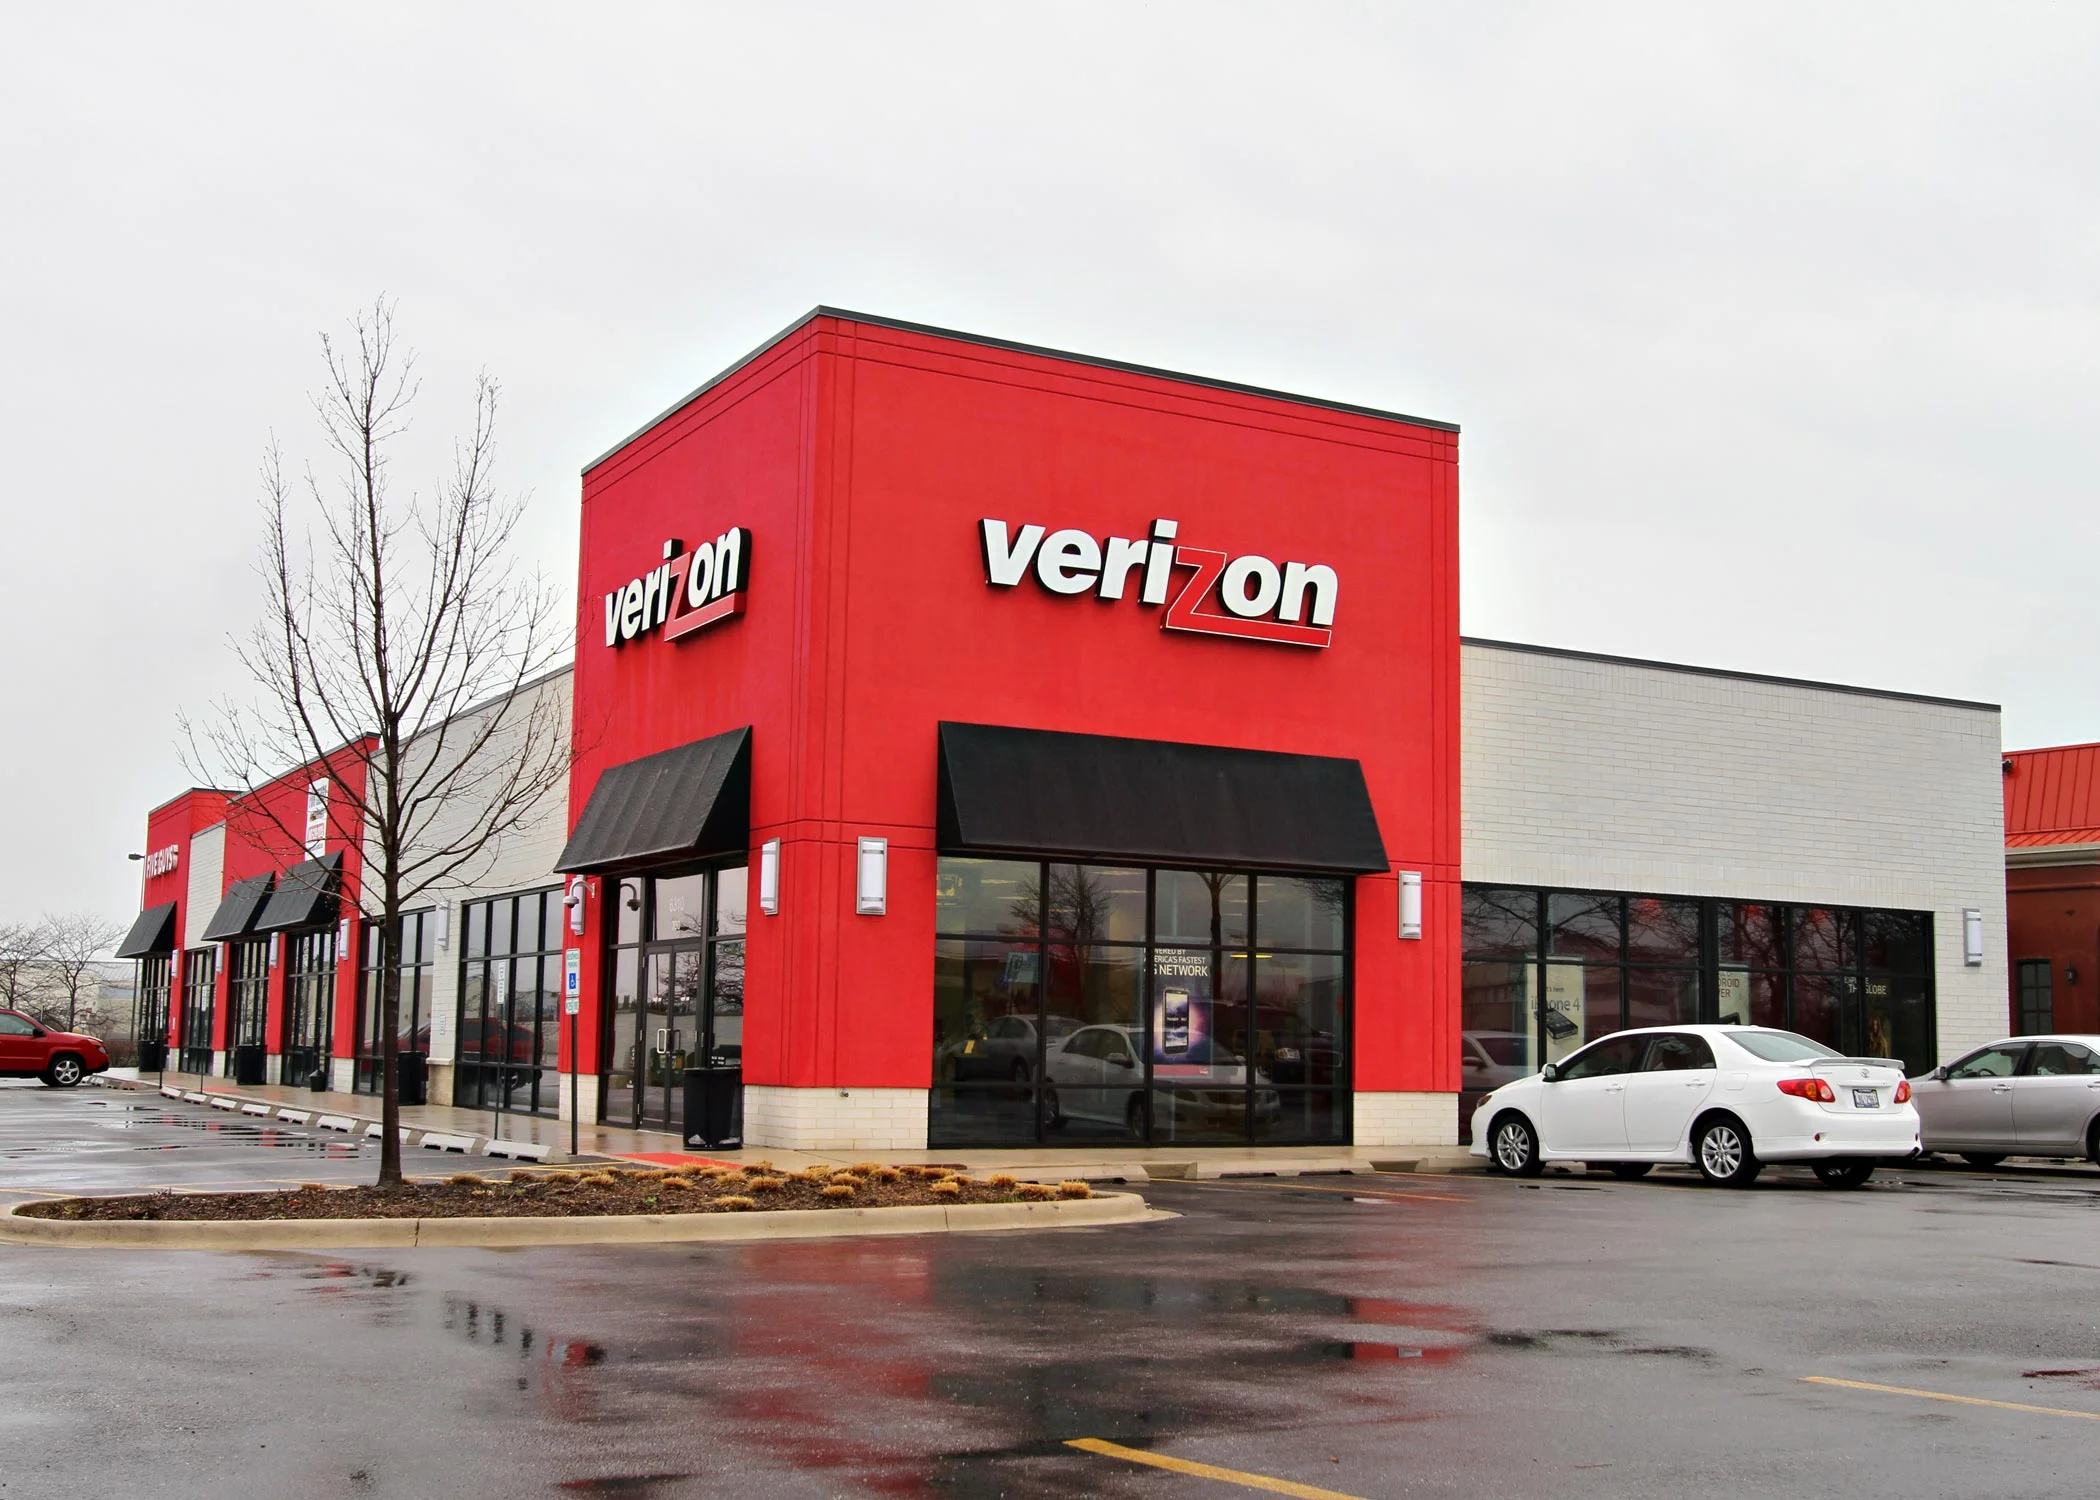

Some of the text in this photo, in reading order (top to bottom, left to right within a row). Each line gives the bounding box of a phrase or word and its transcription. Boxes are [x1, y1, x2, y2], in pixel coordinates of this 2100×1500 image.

[605, 526, 742, 648] verizon
[980, 517, 1339, 648] verizon
[1178, 956, 1206, 965] FASTEST
[1159, 965, 1208, 977] NETWORK
[1572, 998, 1581, 1011] 4
